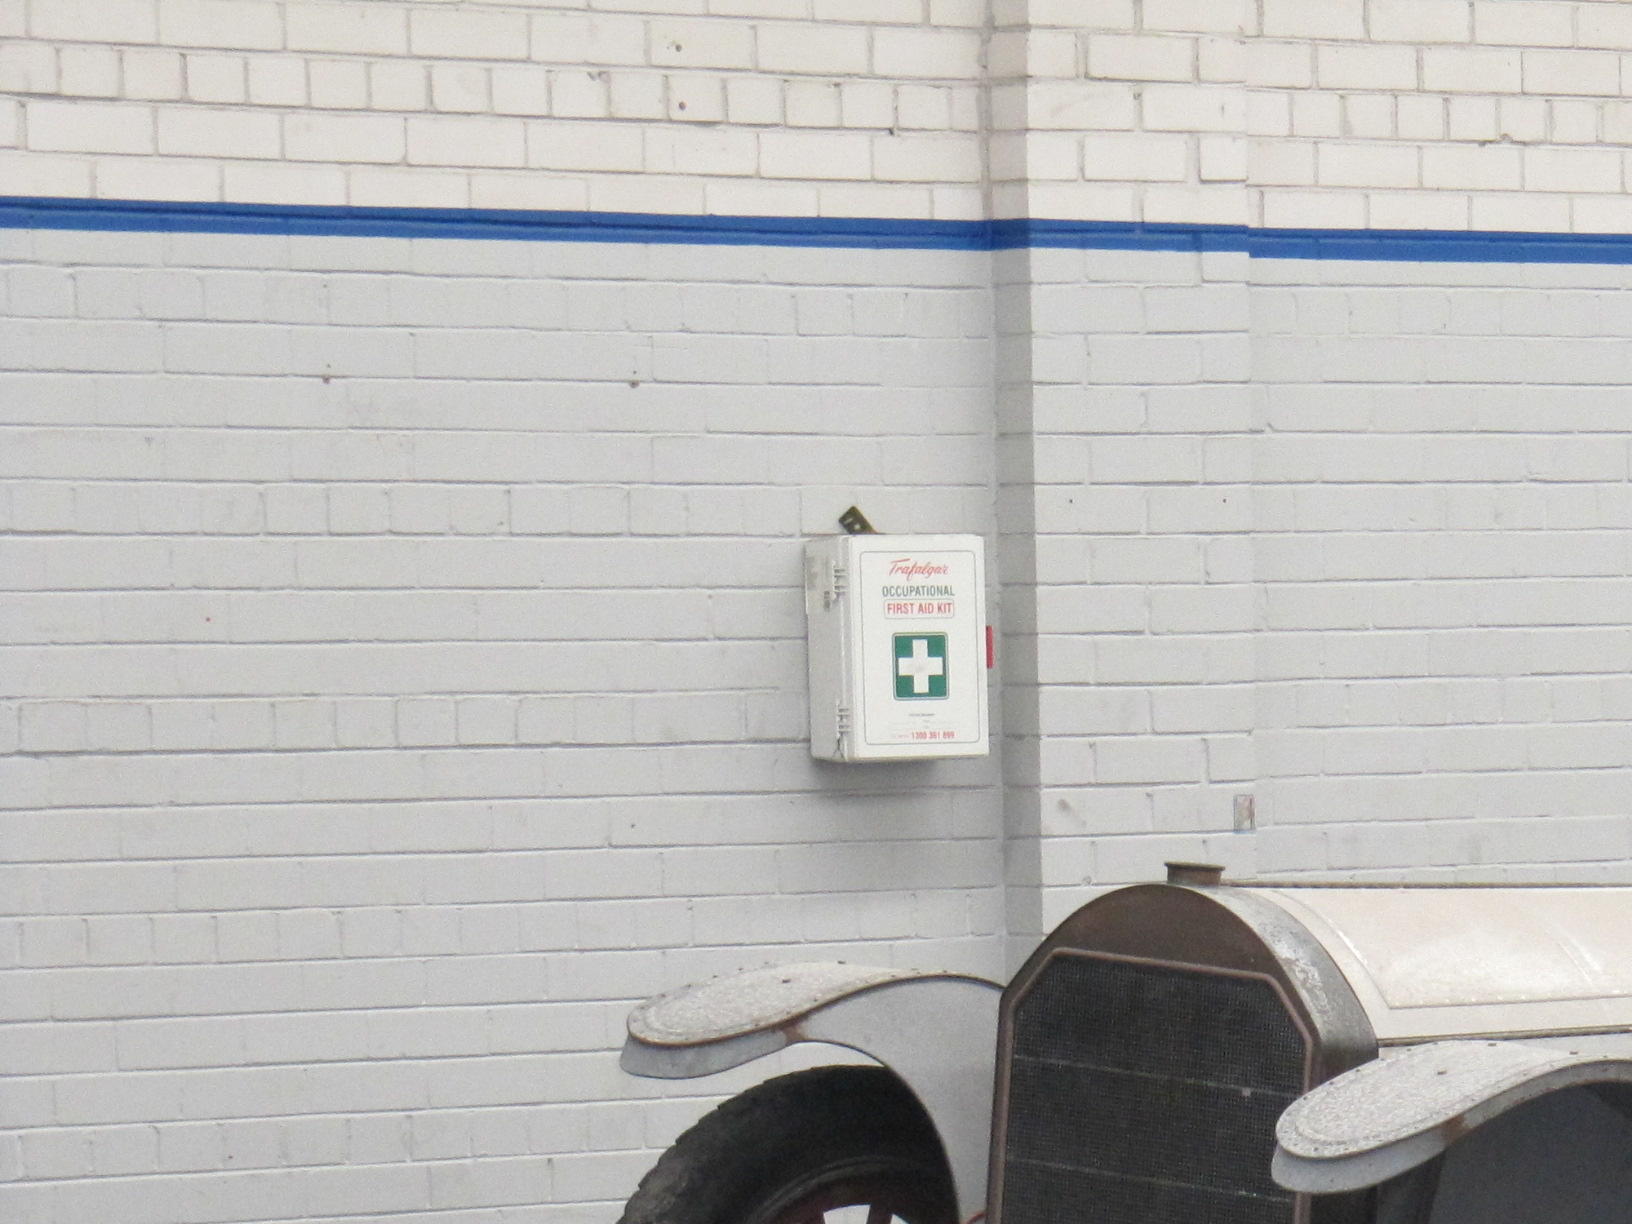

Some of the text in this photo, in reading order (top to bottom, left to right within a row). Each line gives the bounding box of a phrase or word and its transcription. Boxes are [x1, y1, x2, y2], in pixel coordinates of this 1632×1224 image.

[889, 558, 949, 581] Trafalgar
[882, 585, 955, 597] OCCUPATIONAL
[887, 602, 952, 614] FIRST AID KIT
